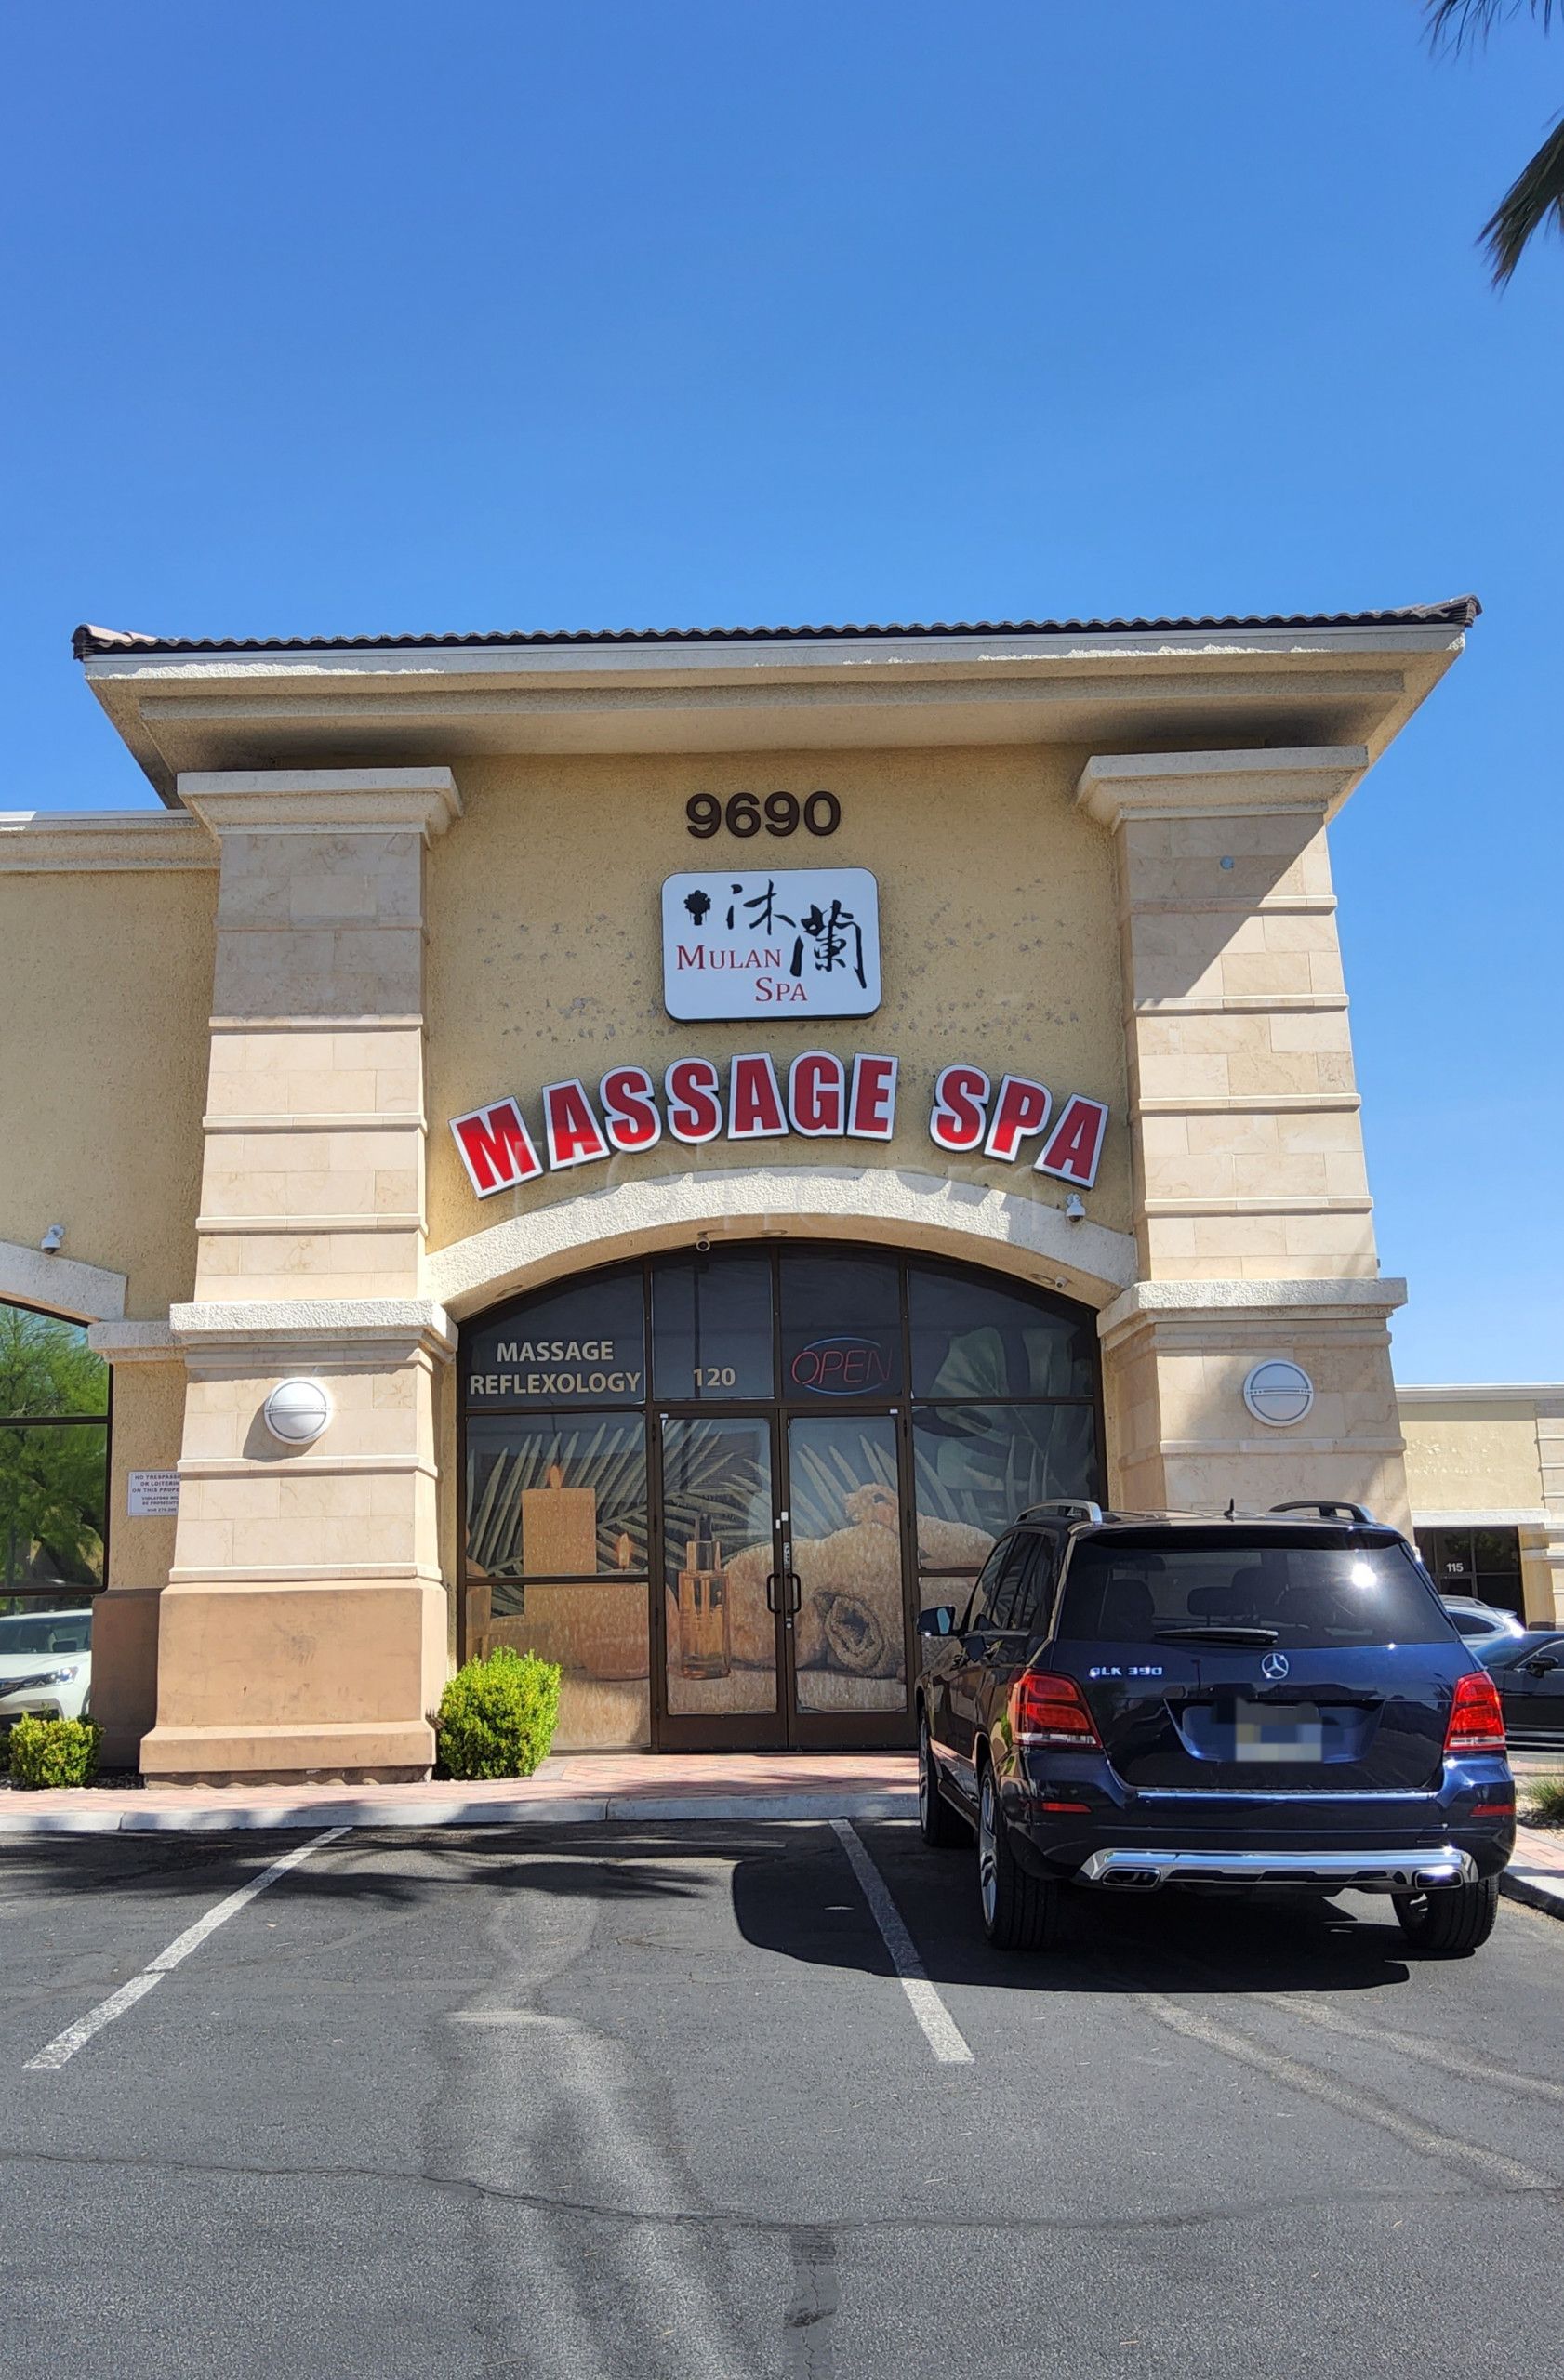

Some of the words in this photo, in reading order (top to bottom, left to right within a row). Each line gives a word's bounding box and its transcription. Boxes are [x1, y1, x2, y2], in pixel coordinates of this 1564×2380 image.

[685, 791, 842, 838] 9690
[448, 1050, 899, 1199] MASSAGE
[930, 1064, 1110, 1190] SPA
[496, 1340, 614, 1362] MASSAGE
[693, 1367, 736, 1387] 120
[791, 1348, 893, 1386] OPEN
[470, 1371, 641, 1395] REFLEXOLOGY
[1446, 1563, 1464, 1573] 115
